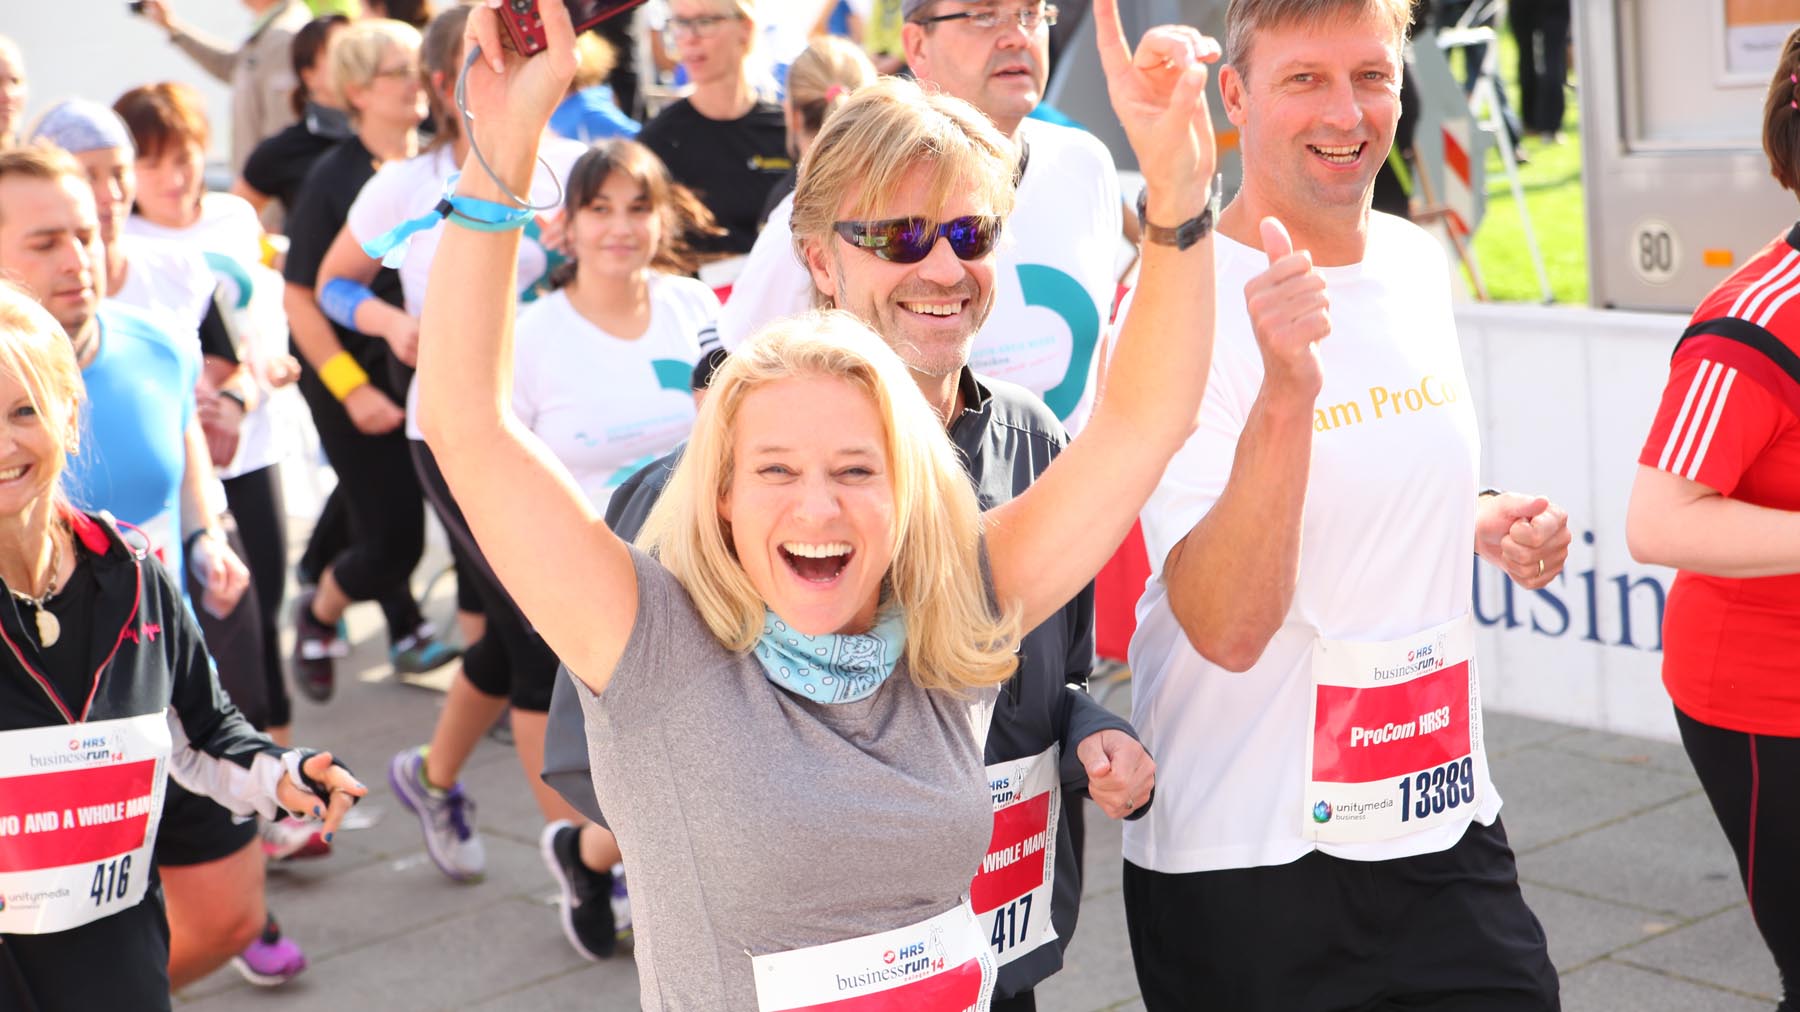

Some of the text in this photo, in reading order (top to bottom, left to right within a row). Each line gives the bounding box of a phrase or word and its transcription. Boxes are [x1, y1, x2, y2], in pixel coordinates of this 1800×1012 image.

[1639, 231, 1672, 273] 80
[1314, 401, 1362, 432] am
[1416, 645, 1432, 658] HRS
[82, 738, 106, 749] HRS
[1350, 706, 1450, 748] ProCom HRS3
[1336, 756, 1475, 823] unitymedia 13389
[24, 811, 59, 834] AND
[63, 808, 75, 829] A
[77, 801, 124, 827] WHOLE
[125, 794, 152, 819] MAN
[982, 830, 1046, 874] WHOLE MAN
[90, 854, 132, 907] 416
[991, 892, 1033, 954] 417
[900, 942, 924, 960] HRS
[931, 957, 944, 972] 14
